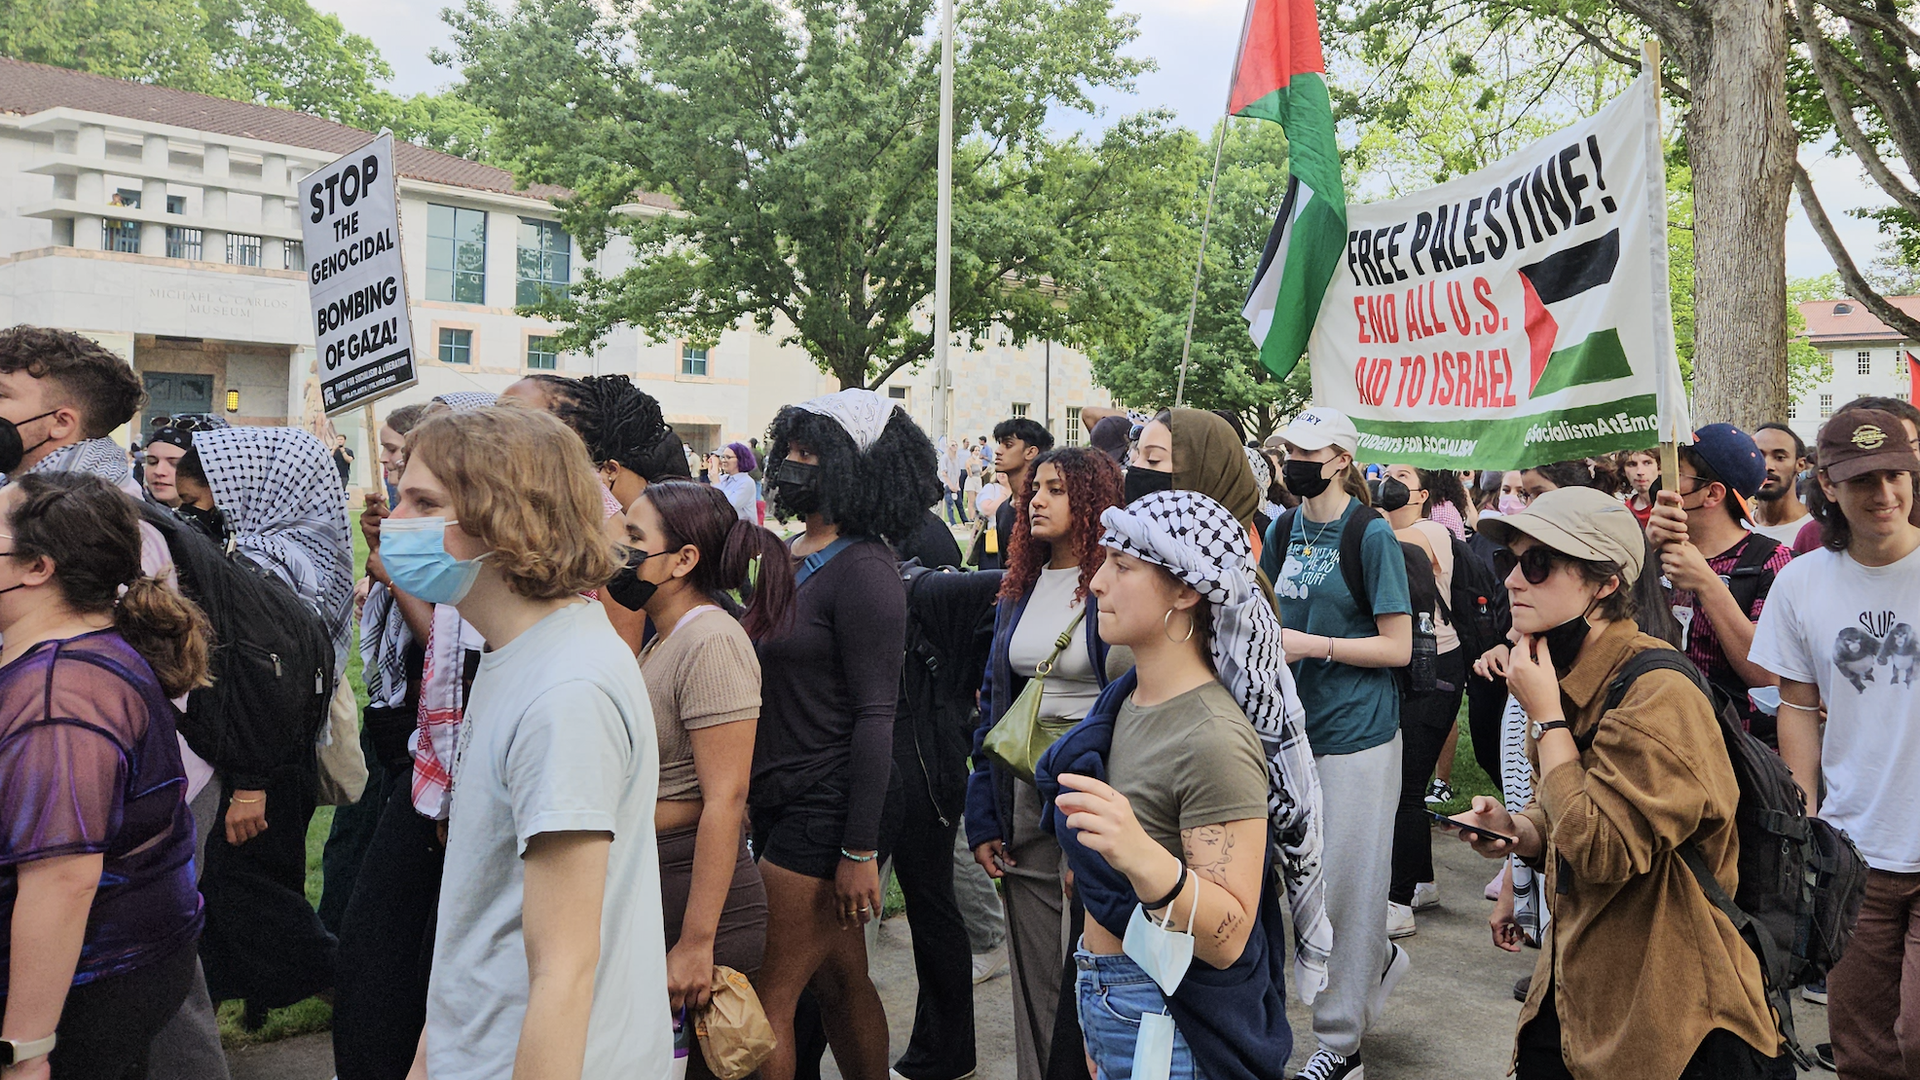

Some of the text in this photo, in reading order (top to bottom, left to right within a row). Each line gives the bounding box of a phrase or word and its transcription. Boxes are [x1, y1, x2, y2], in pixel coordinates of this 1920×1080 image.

[310, 155, 378, 224] STOP
[333, 211, 358, 242] THE
[1348, 134, 1617, 286] FREE PALESTINE!
[311, 228, 394, 285] GENOCIDAL
[149, 288, 214, 303] MICHAEL
[234, 296, 288, 309] CARLOS
[190, 304, 251, 318] MUSEUM
[318, 276, 397, 336] BOMBING
[1354, 276, 1508, 343] END ALL U.S.
[325, 317, 397, 371] OF GAZA!
[1355, 348, 1516, 408] AID TO ISRAEL
[1297, 413, 1321, 425] ORY
[1524, 412, 1658, 447] @SocialismAtEmo
[1357, 432, 1478, 457] TUDENTS FOR SOCIALISM
[1299, 571, 1327, 585] STUFF
[1304, 558, 1335, 573] ME DO
